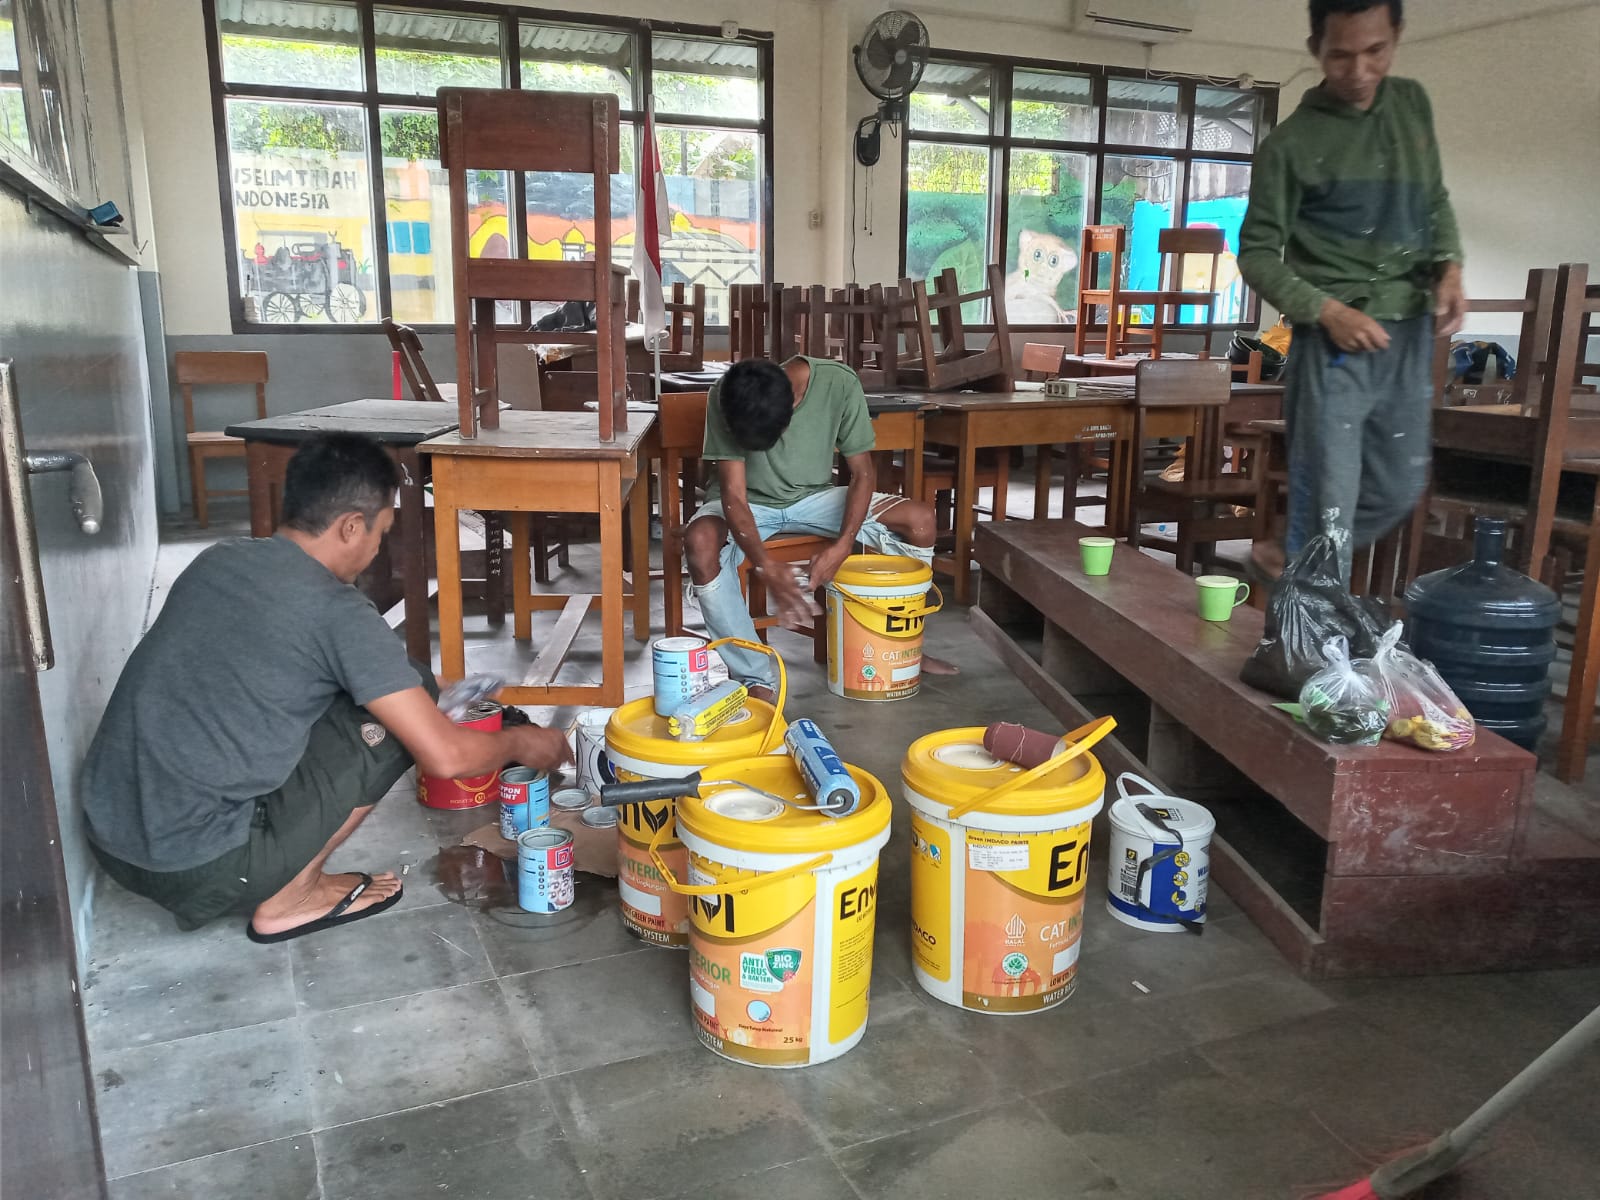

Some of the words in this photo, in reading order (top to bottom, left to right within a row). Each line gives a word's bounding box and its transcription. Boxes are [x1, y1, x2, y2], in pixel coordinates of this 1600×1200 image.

[881, 650, 900, 662] CAT
[642, 927, 670, 943] SYSTEM
[1039, 919, 1067, 943] CAT
[742, 956, 764, 968] ANTI
[773, 954, 793, 962] BIO
[742, 964, 768, 976] VIRUS
[772, 961, 794, 970] ZINC
[1042, 988, 1064, 1004] WATER
[783, 1036, 794, 1044] 25
